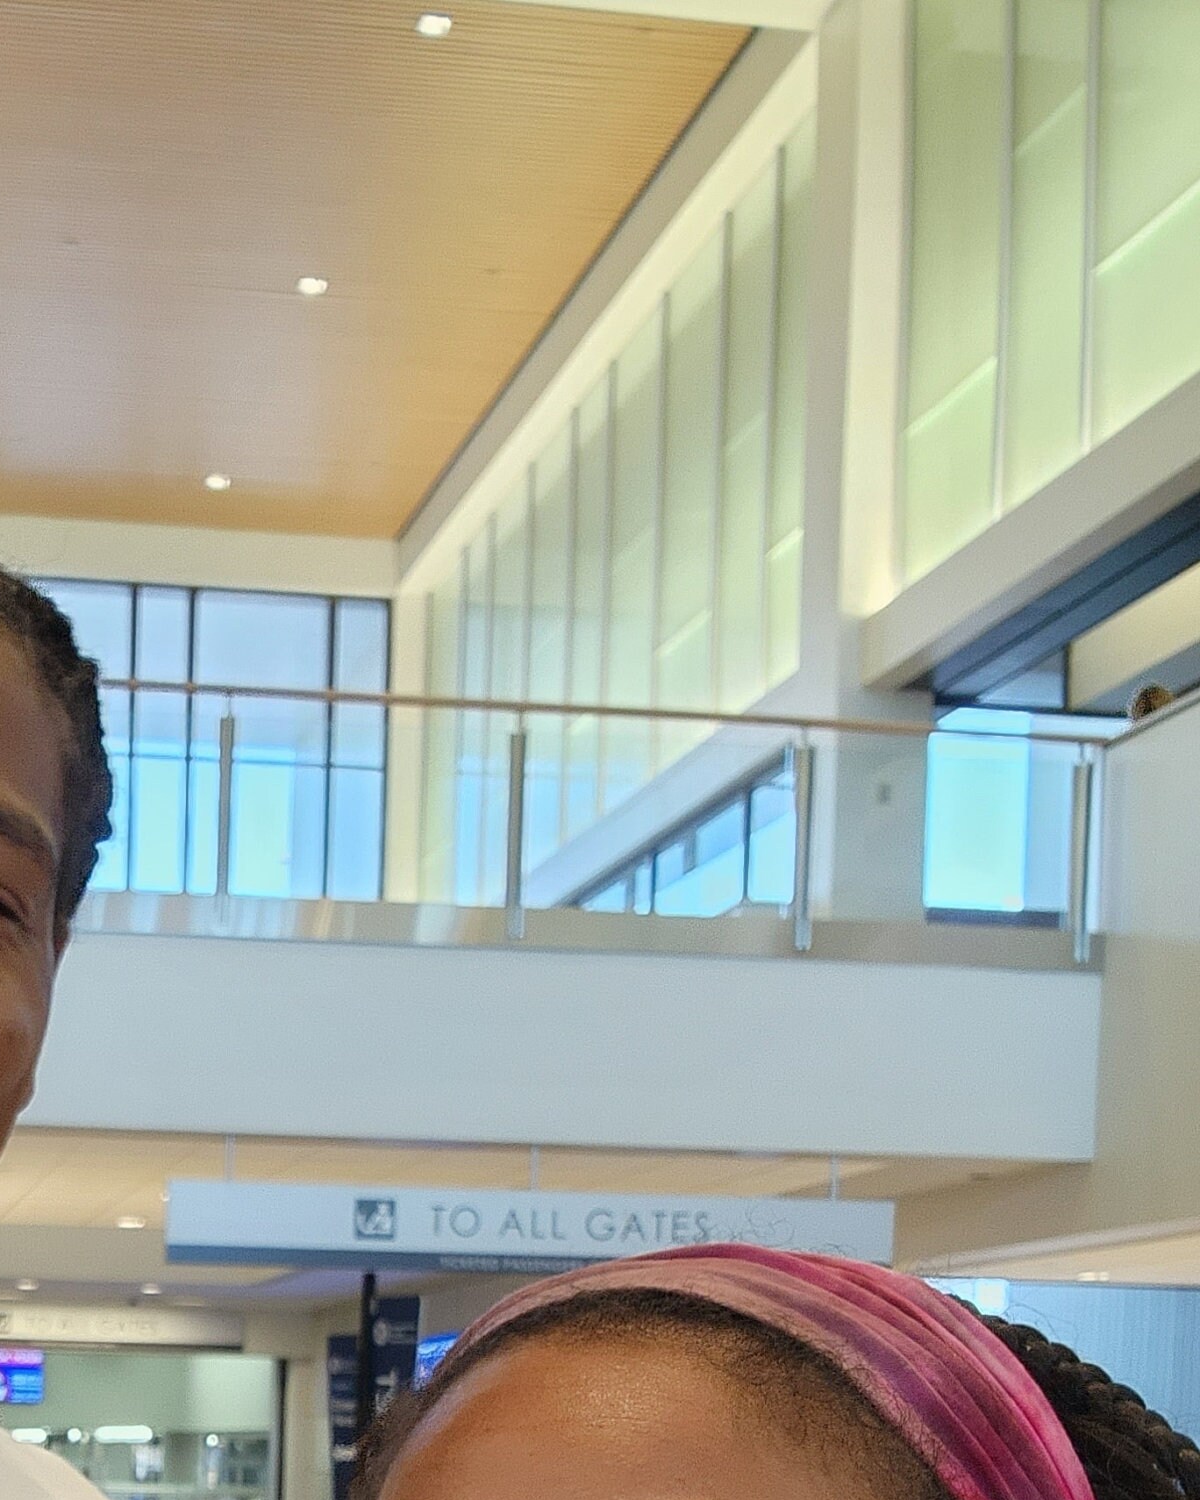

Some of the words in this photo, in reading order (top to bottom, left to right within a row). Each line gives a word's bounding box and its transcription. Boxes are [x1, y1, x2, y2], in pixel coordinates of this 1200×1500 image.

[430, 1204, 482, 1239] TO
[499, 1206, 566, 1240] ALL
[585, 1207, 709, 1243] GATES
